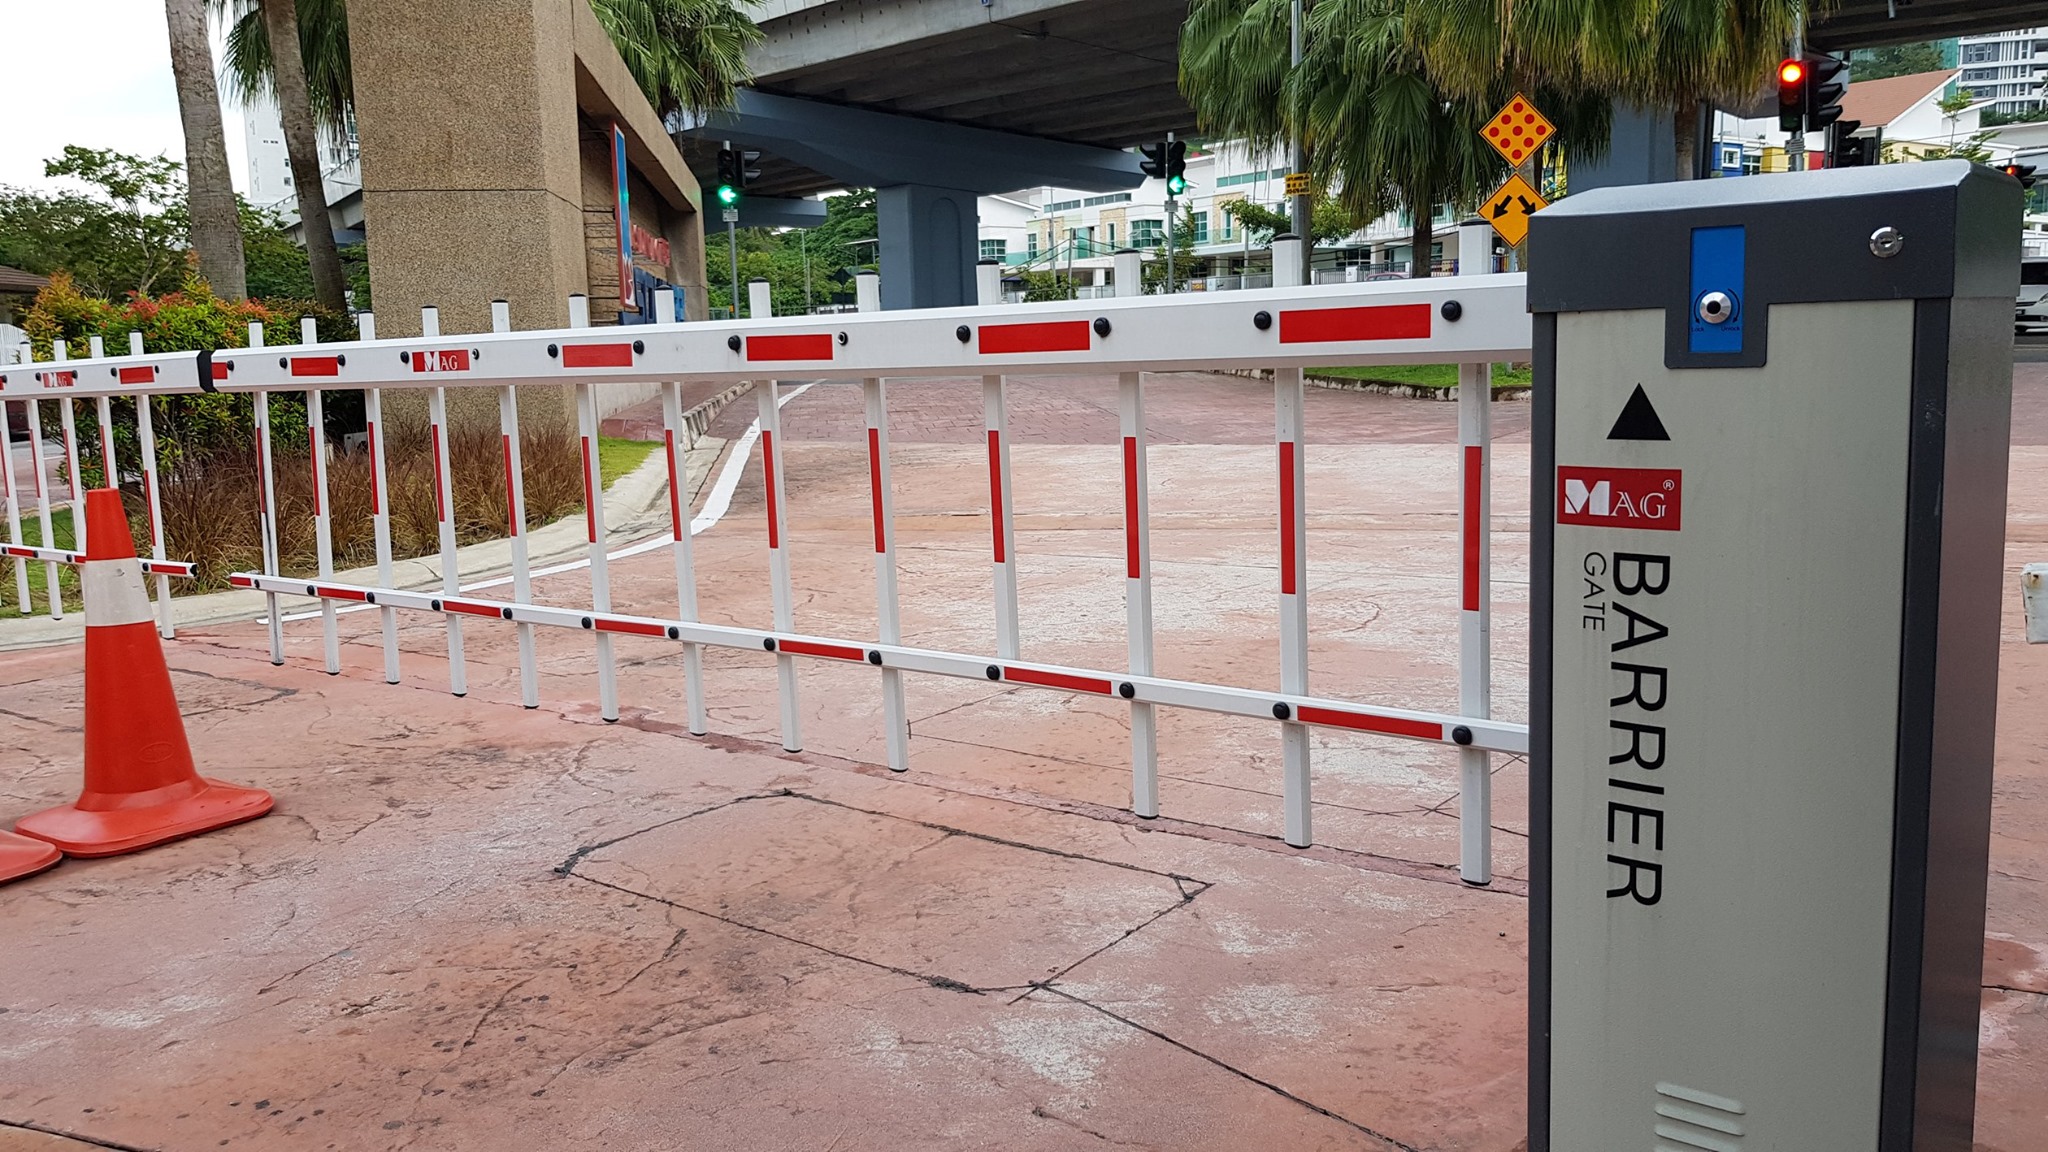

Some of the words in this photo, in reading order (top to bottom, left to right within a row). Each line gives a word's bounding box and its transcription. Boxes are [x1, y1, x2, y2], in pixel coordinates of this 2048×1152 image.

[423, 351, 458, 371] MAG
[1583, 551, 1606, 631] GATE
[1606, 552, 1671, 906] BARRIER
